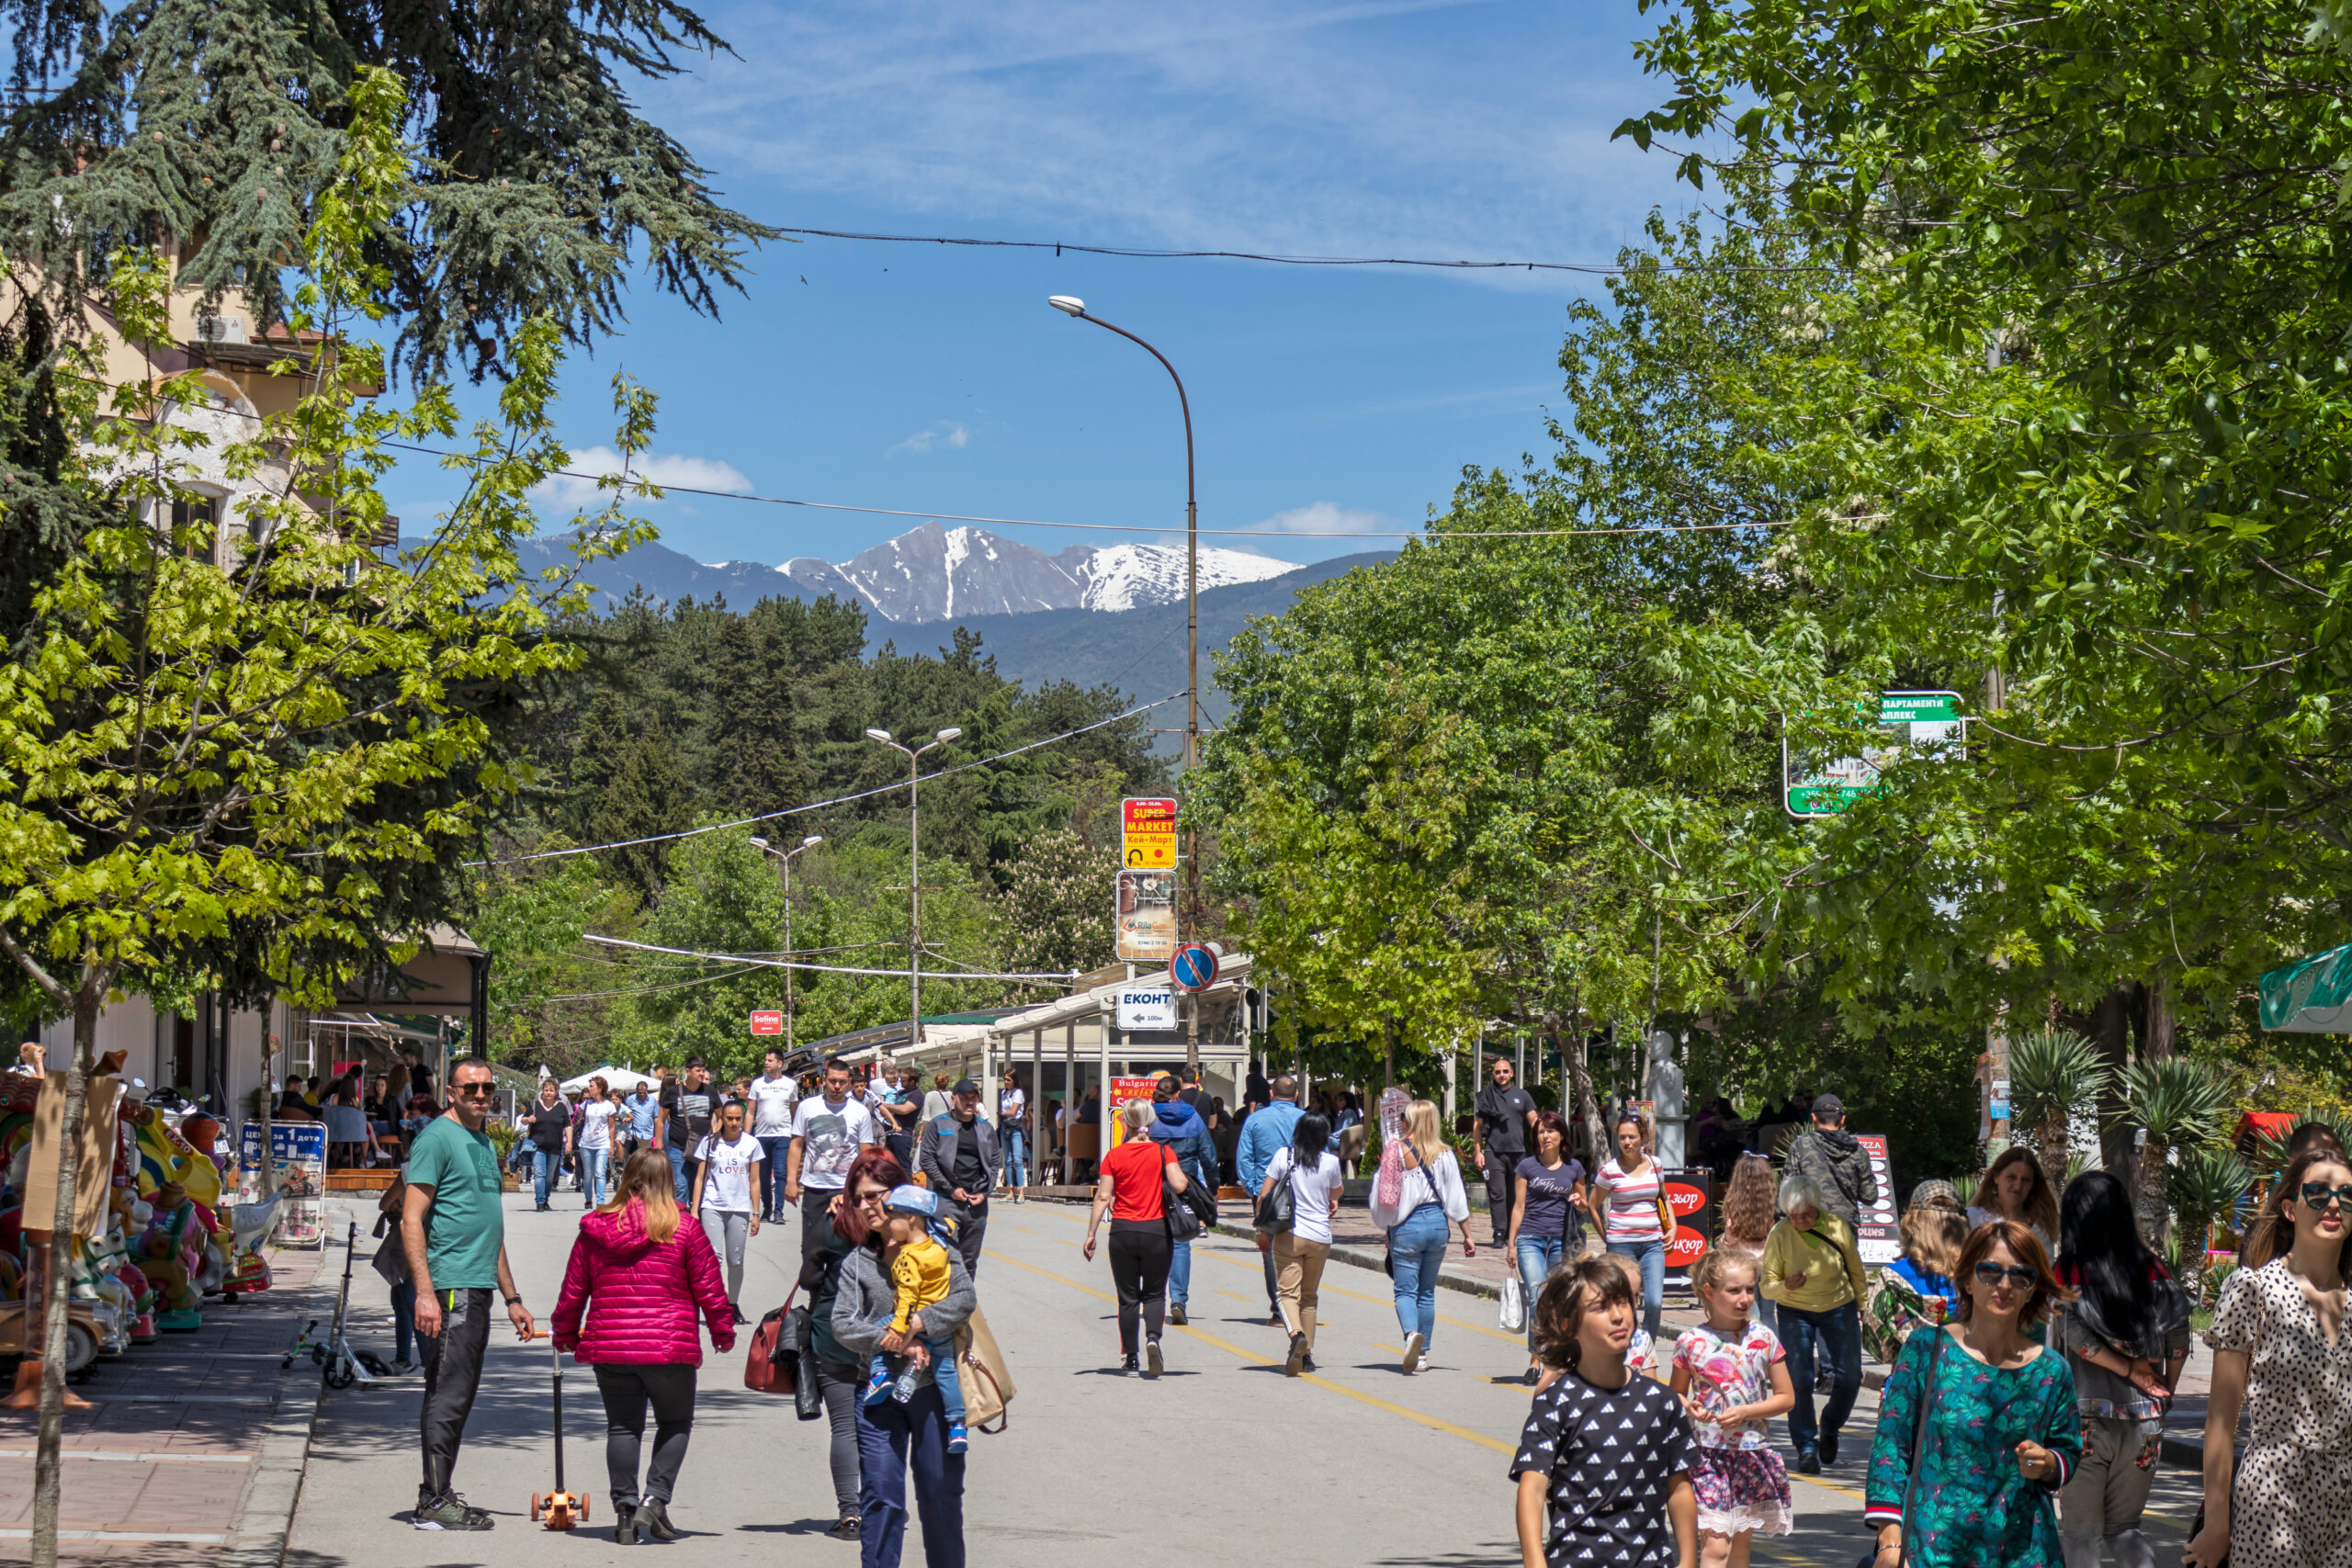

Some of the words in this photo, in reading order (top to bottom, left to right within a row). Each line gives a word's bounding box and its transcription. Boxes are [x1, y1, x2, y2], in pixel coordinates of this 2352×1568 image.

[1883, 699, 1943, 708] ПАРТАМЕНТИ
[1880, 711, 1917, 719] МПЛЕКС
[1133, 808, 1166, 819] SUPER
[1126, 821, 1173, 832] MARKET
[1124, 994, 1171, 1004] ЕКОНТ
[1118, 1079, 1158, 1088] Bulgaria
[288, 1128, 296, 1141] 1
